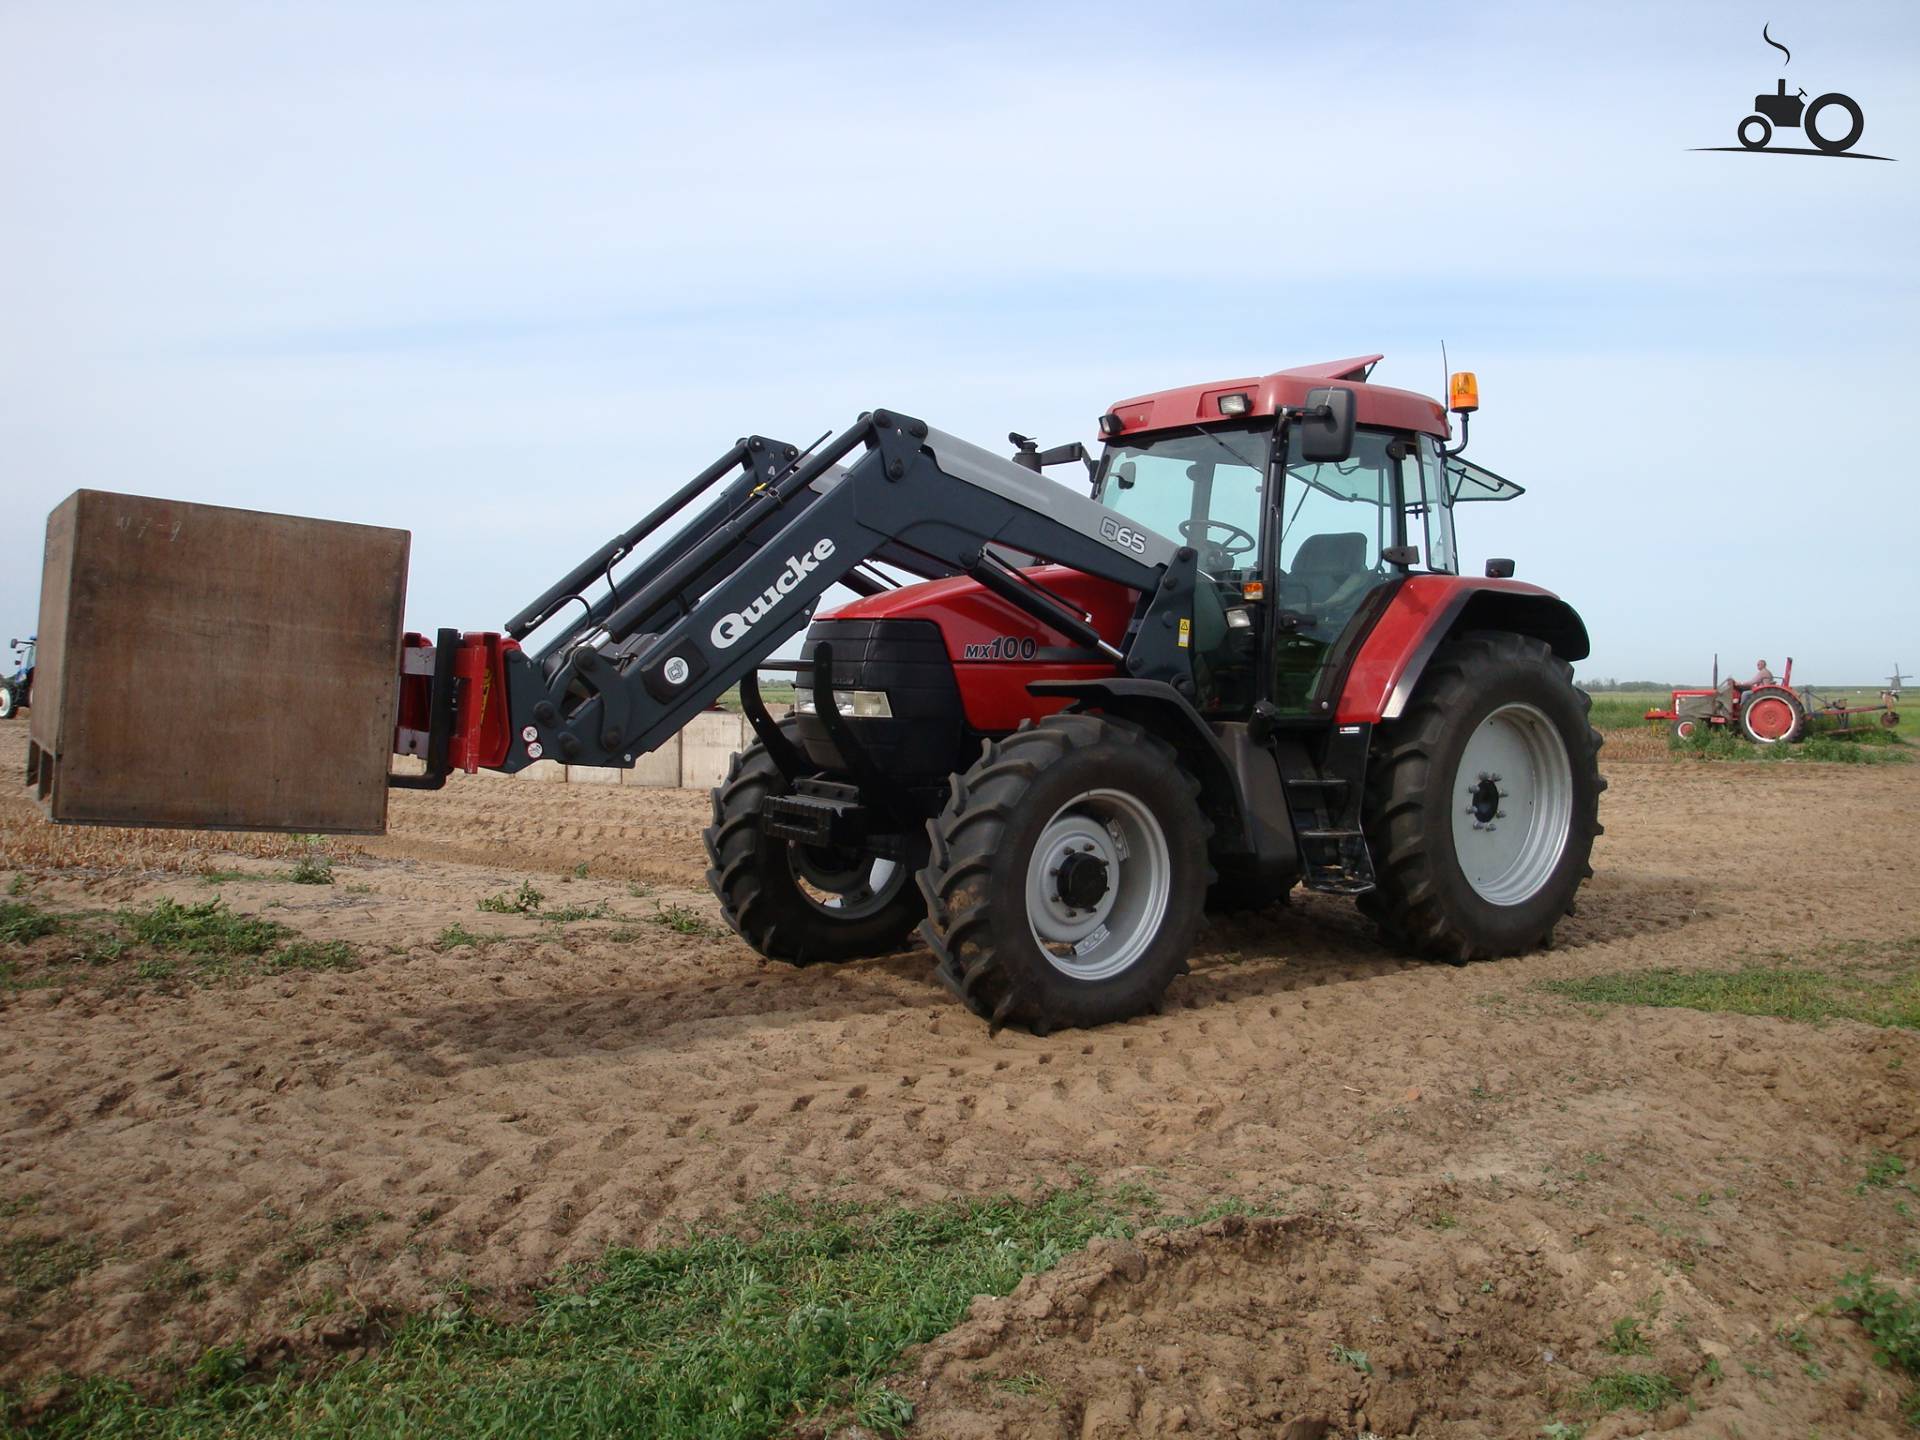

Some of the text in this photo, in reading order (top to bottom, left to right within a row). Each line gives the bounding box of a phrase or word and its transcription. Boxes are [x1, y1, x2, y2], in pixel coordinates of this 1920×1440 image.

[1100, 516, 1146, 554] Q65
[711, 538, 836, 649] Quicke
[964, 636, 1037, 660] MX100
